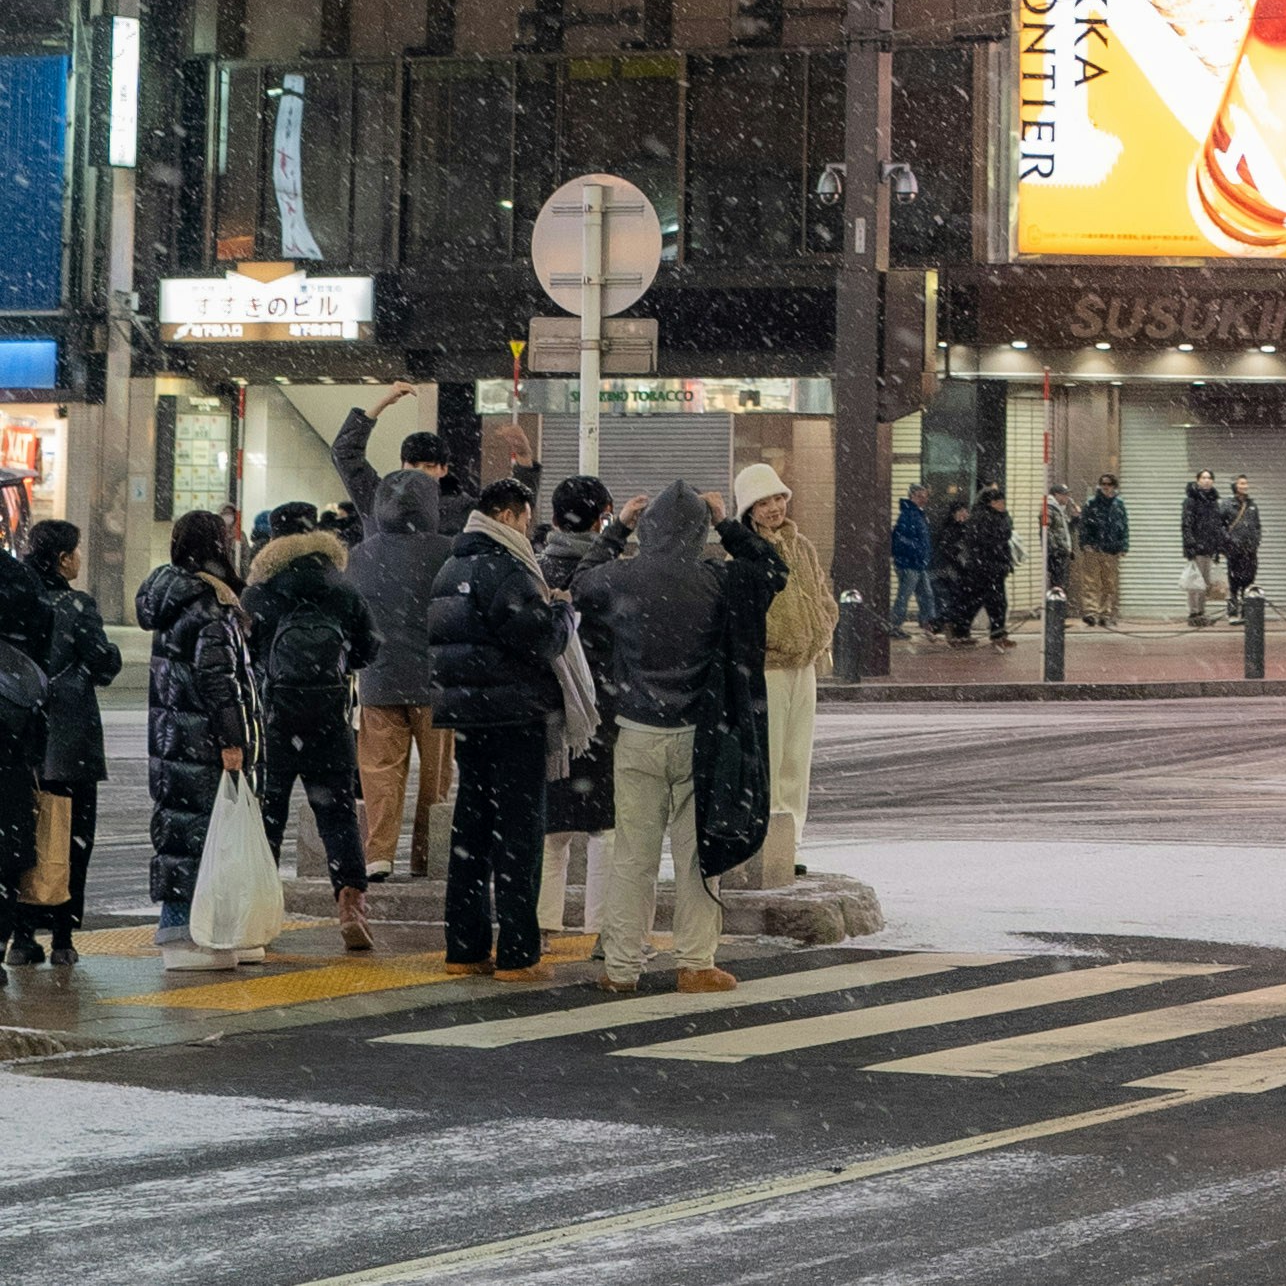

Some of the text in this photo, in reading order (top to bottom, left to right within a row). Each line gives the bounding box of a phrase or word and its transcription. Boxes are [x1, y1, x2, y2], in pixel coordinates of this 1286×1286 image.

[194, 295, 339, 318] すすきのビル
[633, 391, 694, 402] TOBACCO
